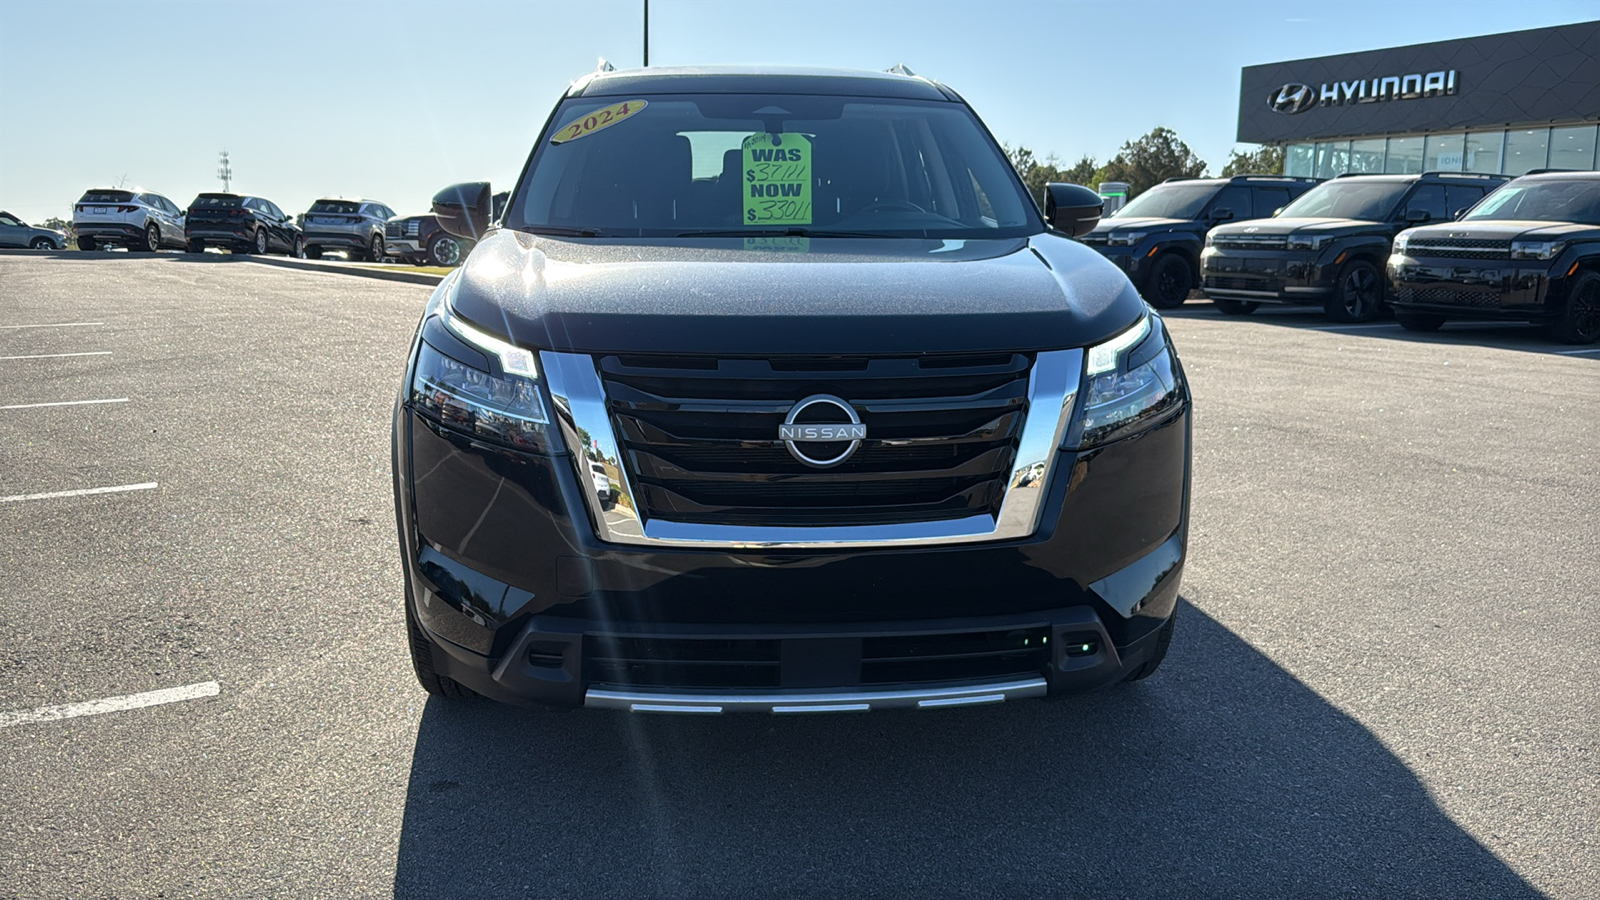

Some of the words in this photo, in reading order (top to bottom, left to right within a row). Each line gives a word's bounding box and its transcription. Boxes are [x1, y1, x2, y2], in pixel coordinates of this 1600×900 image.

[1320, 70, 1459, 107] HYUNDAI
[568, 103, 630, 139] 2024
[751, 148, 802, 162] WAS
[1441, 156, 1463, 165] IONI
[750, 183, 803, 198] NOW
[781, 427, 864, 439] NISSAN
